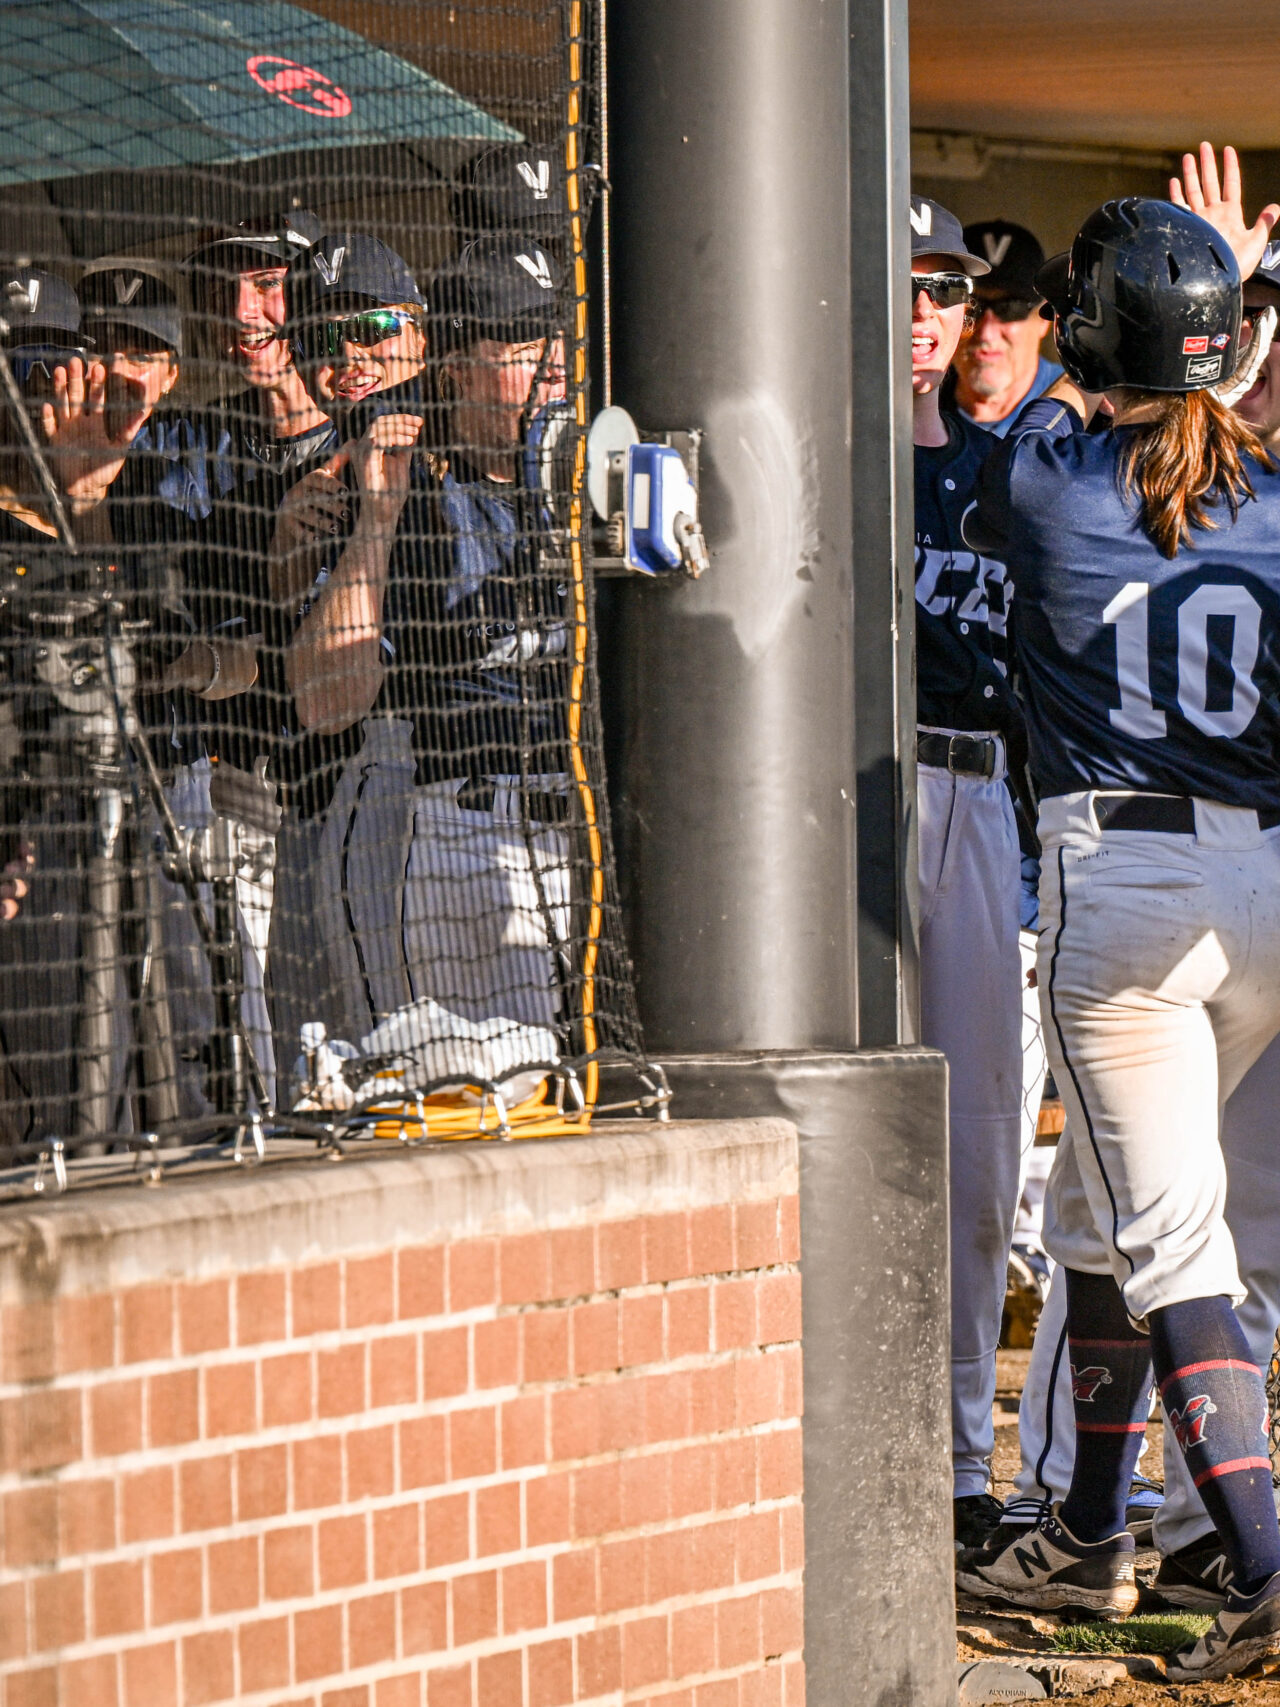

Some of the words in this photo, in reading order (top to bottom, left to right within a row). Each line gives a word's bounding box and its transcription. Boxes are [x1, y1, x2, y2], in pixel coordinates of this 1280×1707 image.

[516, 160, 549, 199] V
[315, 246, 345, 285] V
[983, 232, 1012, 266] V
[514, 250, 553, 288] V
[114, 274, 143, 304] V
[1103, 582, 1262, 740] 10
[1013, 1540, 1052, 1579] N
[1200, 1554, 1235, 1590] N
